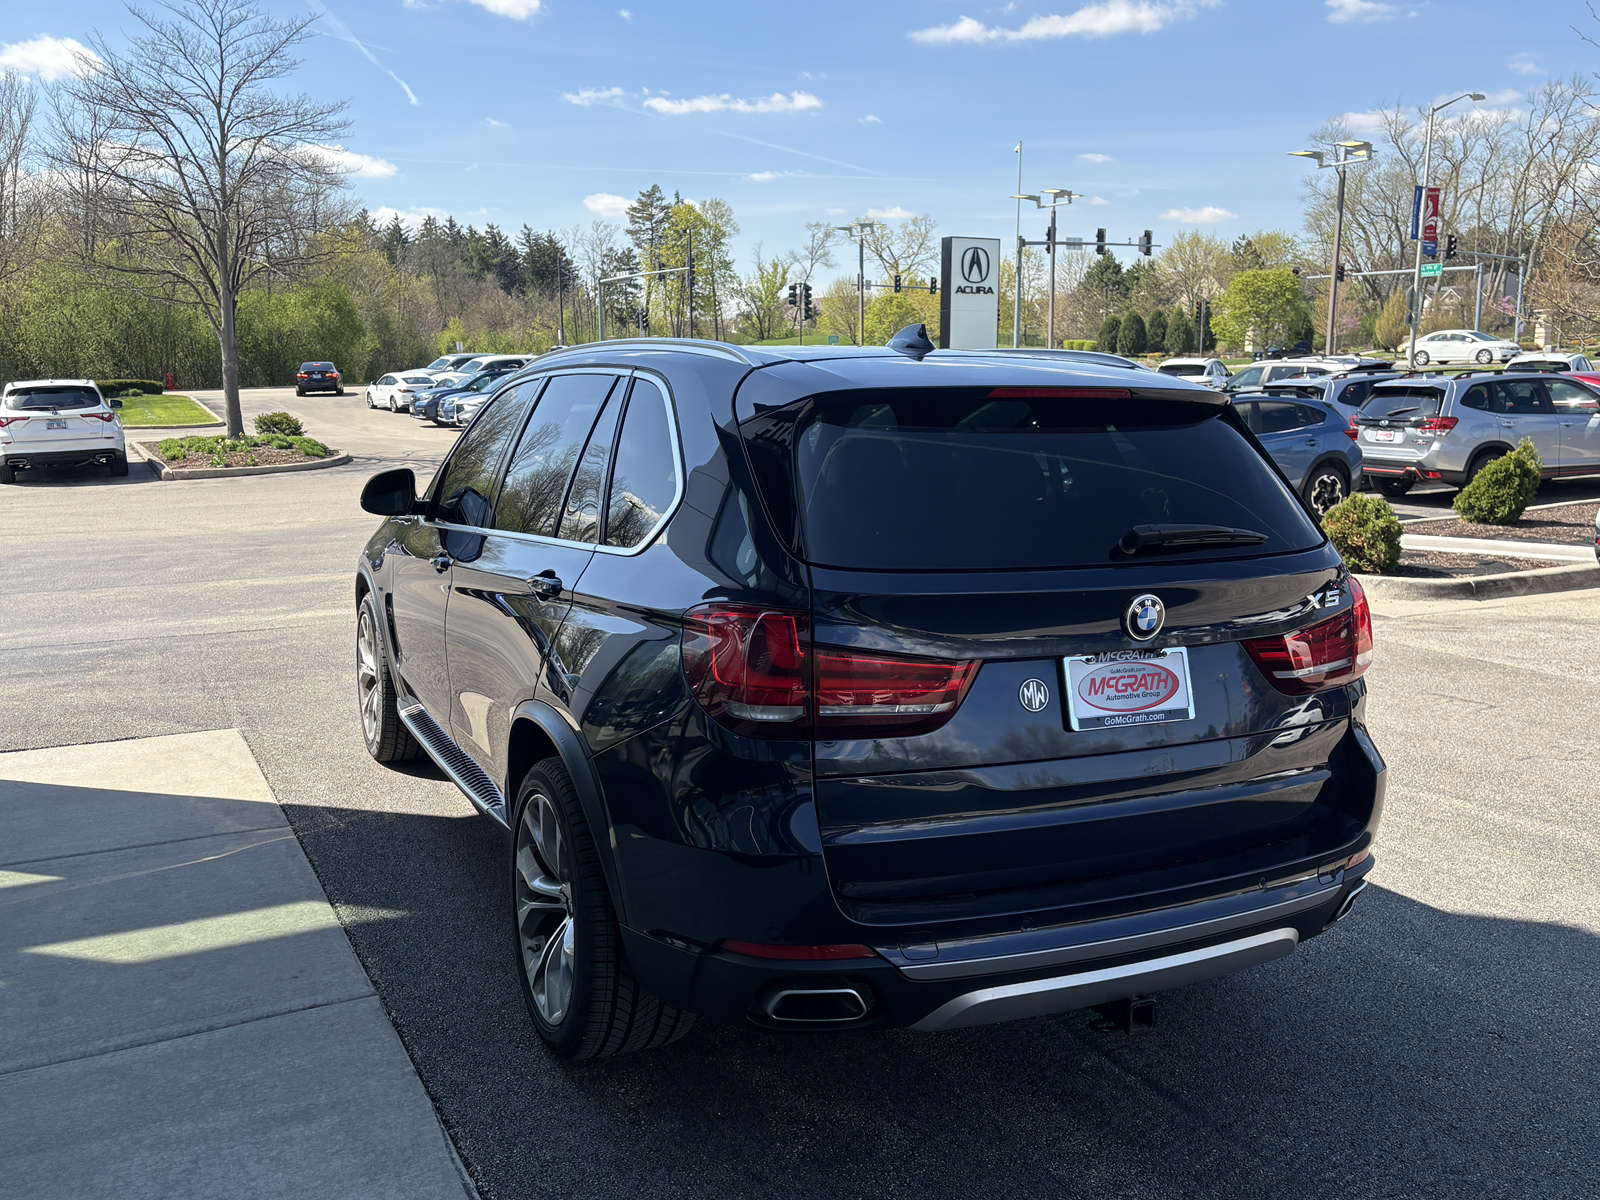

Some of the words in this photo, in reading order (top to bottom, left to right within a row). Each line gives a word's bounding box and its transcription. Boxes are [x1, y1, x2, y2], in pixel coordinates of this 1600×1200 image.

[955, 286, 994, 295] ACURA
[1301, 589, 1340, 611] X5
[1105, 693, 1141, 702] Automotive
[1141, 691, 1161, 699] Group
[1104, 712, 1165, 726] GoMcGrath.com
